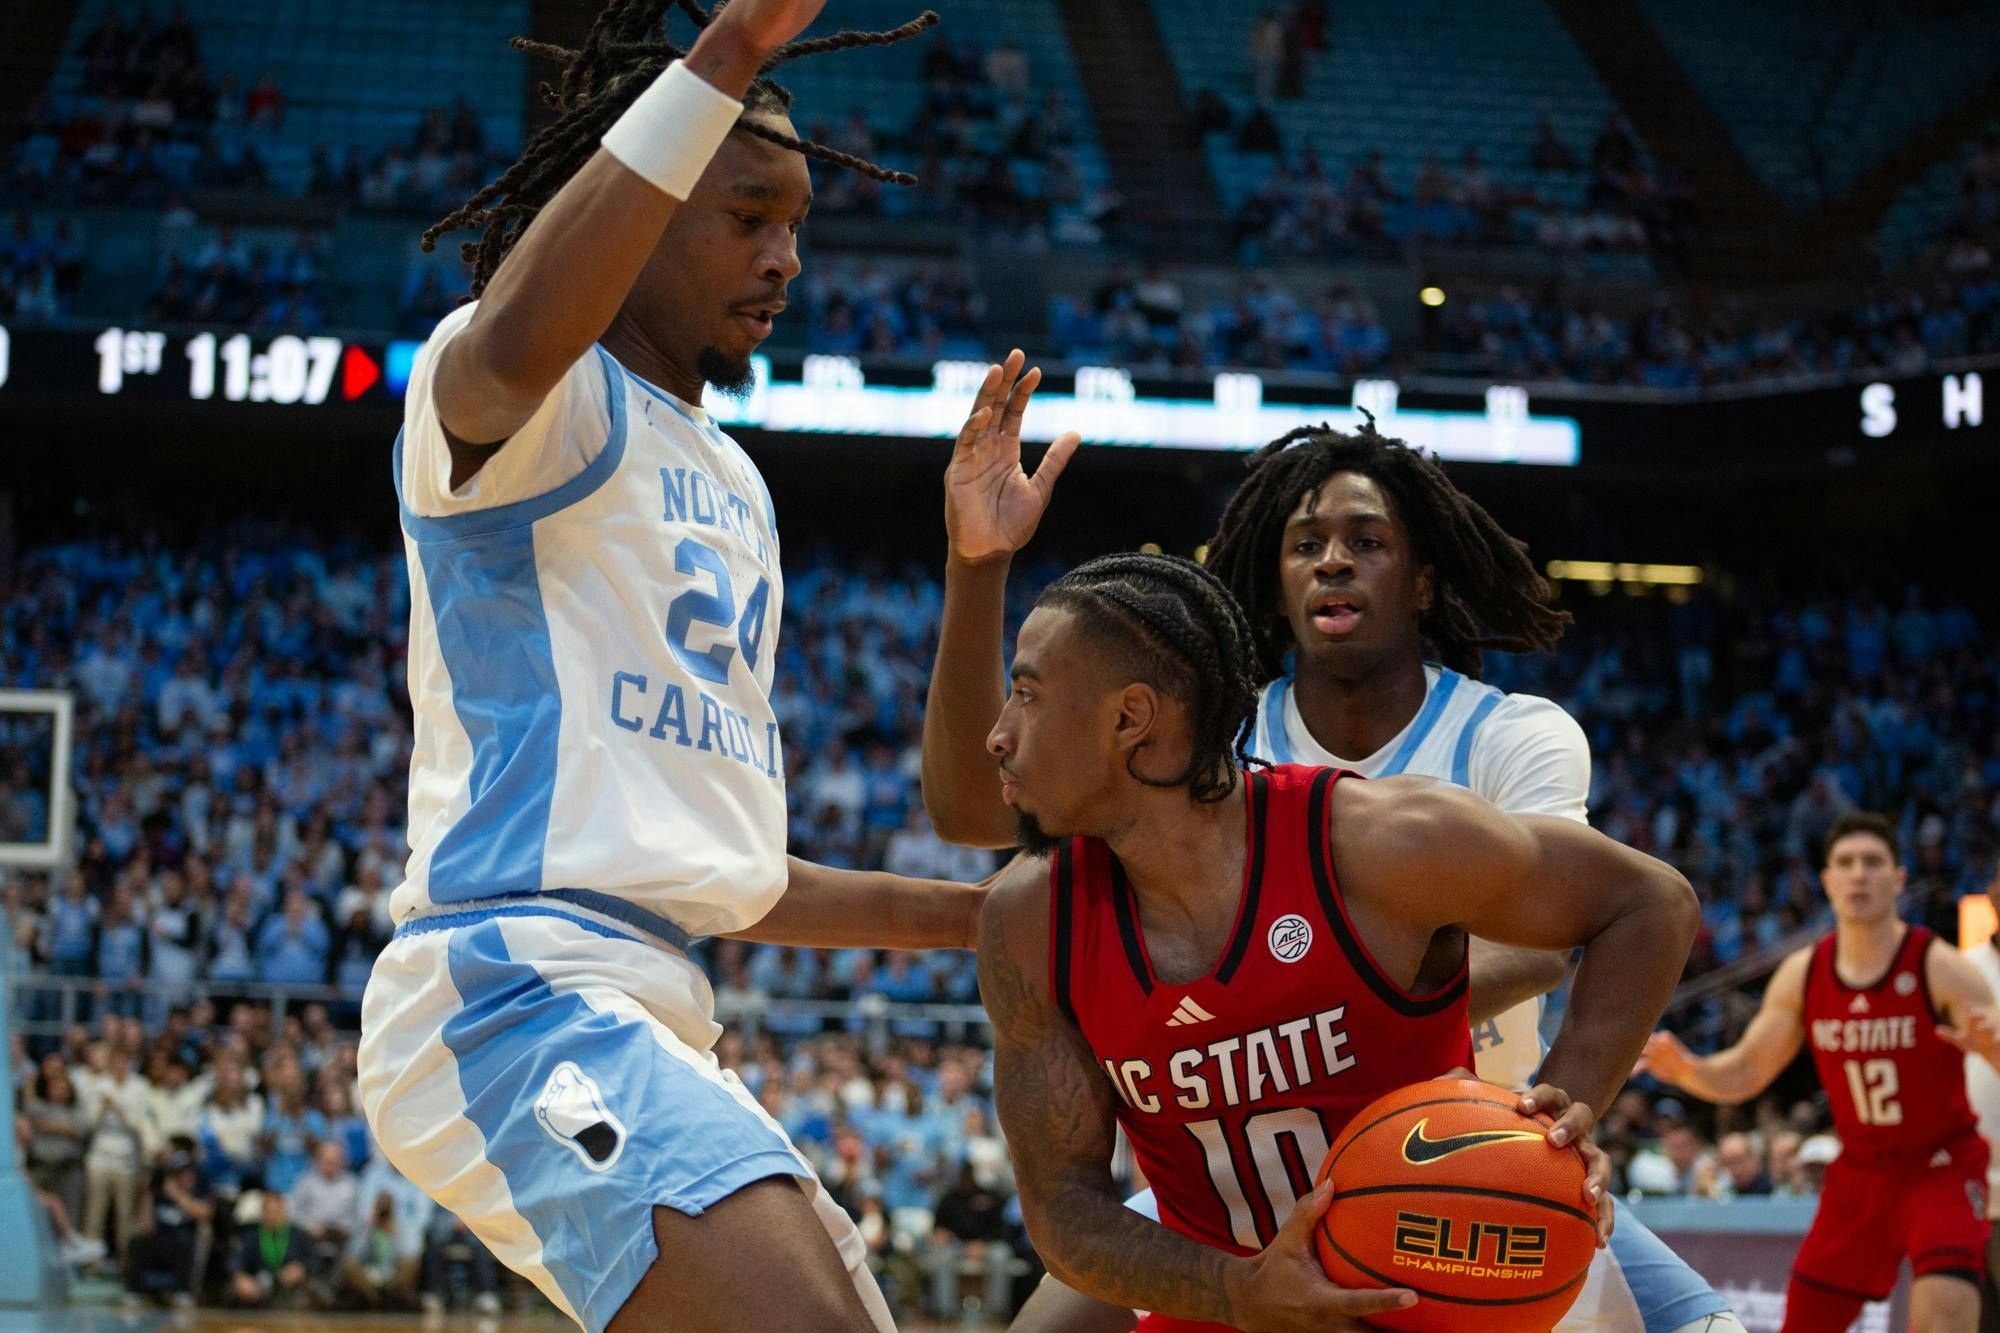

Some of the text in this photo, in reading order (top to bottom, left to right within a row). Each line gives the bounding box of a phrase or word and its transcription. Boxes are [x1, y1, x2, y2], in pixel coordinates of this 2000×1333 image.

[185, 332, 342, 405] 11:07
[1859, 371, 1983, 438] S H
[666, 537, 770, 685] 24
[1276, 925, 1306, 947] ACC
[1168, 1004, 1358, 1111] STATE
[1842, 1015, 1917, 1053] STATE
[1843, 1058, 1903, 1126] 12
[1183, 1106, 1334, 1252] 10
[1392, 1254, 1544, 1280] CHAMPIONSHIP
[1394, 1210, 1548, 1267] ELITE
